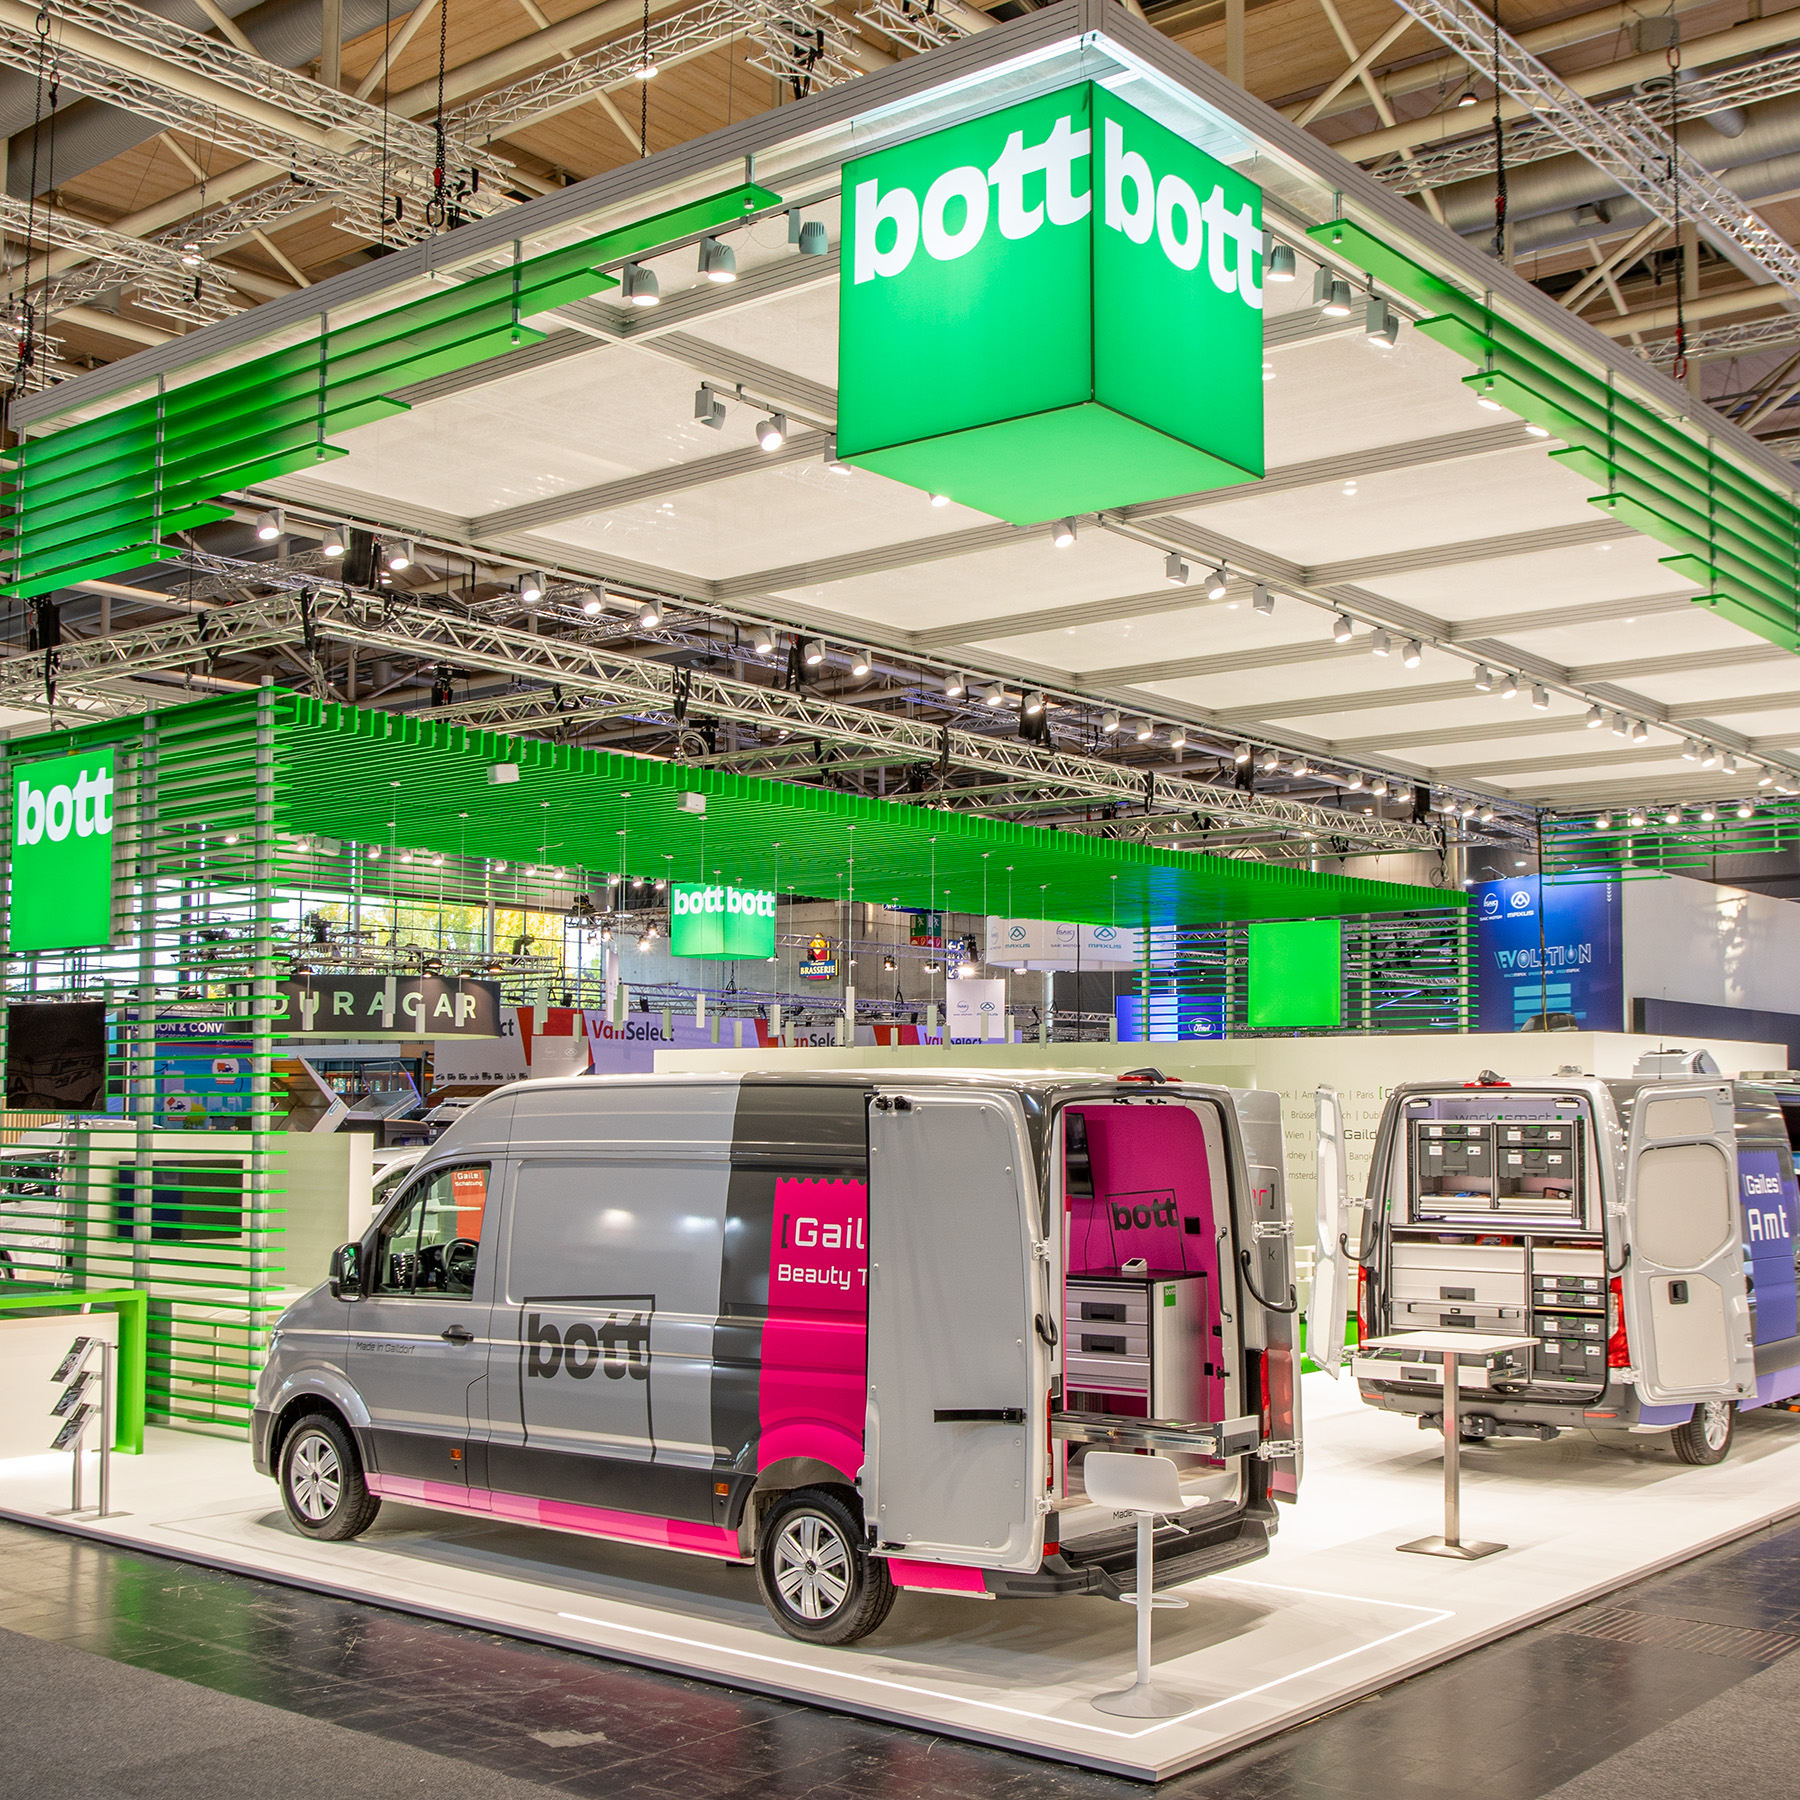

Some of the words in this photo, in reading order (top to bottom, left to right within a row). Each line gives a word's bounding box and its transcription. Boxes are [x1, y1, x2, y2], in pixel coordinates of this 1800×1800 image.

[854, 115, 1092, 285] bott
[1105, 117, 1263, 310] bott
[17, 767, 113, 845] bott
[674, 886, 724, 915] bott
[726, 886, 775, 917] bott
[800, 964, 836, 975] BRASSERIE
[1356, 1090, 1374, 1099] Paris
[1285, 1130, 1304, 1139] Wien
[1111, 1198, 1179, 1231] bott
[1747, 1204, 1790, 1242] Amt
[778, 1264, 851, 1290] Beauty
[527, 1313, 650, 1380] bott
